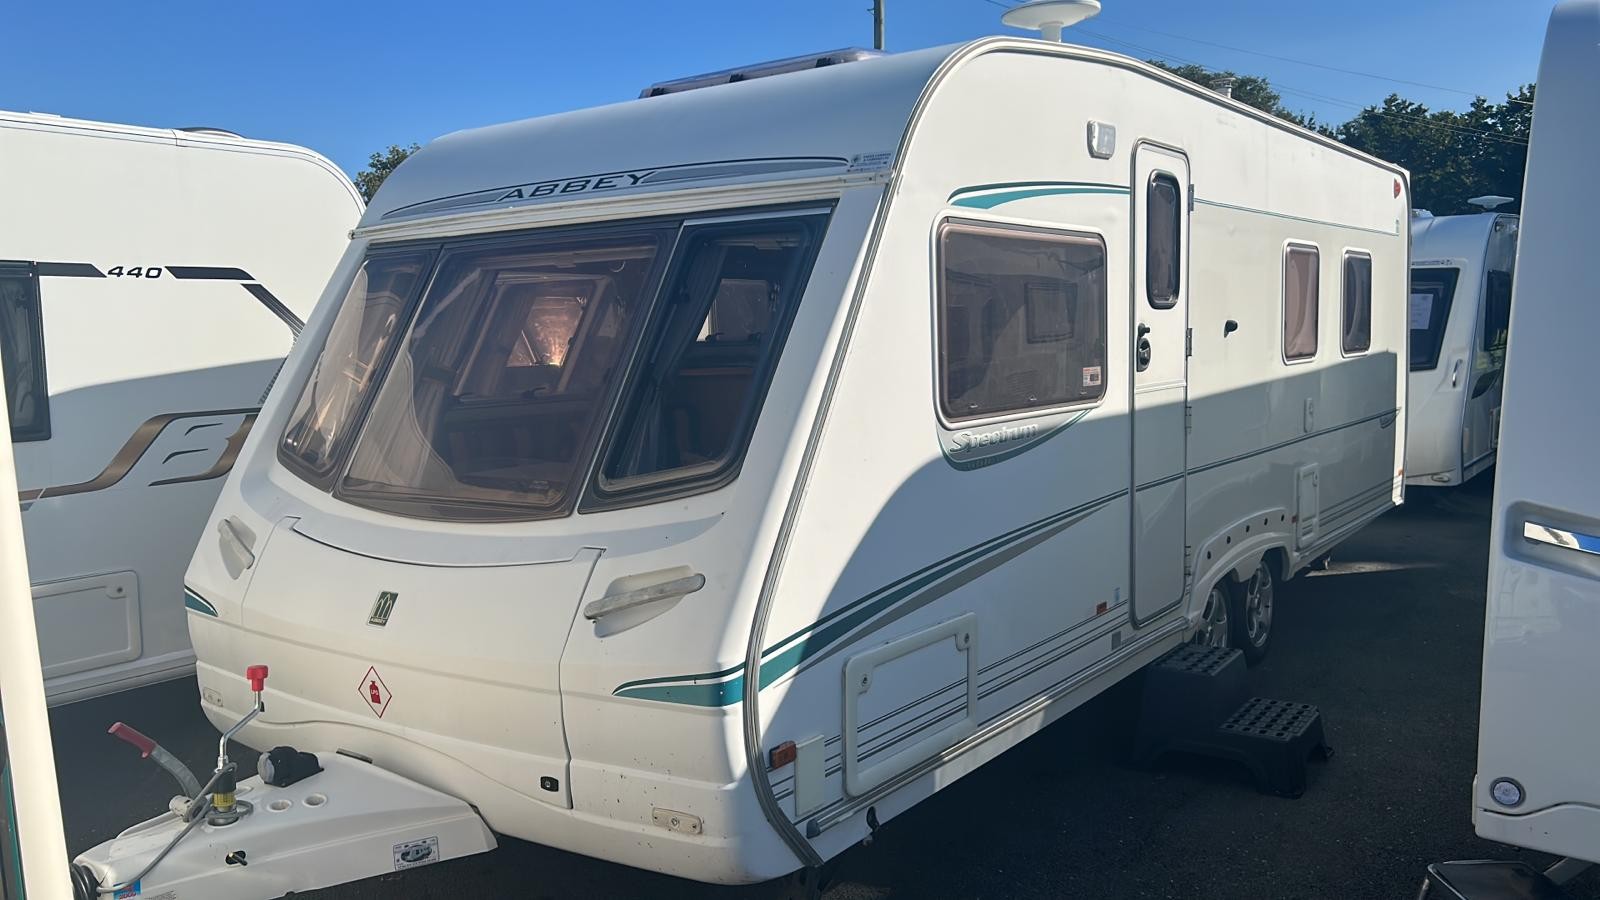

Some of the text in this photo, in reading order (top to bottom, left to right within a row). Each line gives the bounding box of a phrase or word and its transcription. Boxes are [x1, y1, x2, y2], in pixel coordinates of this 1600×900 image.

[497, 171, 656, 202] ABBEY
[107, 265, 163, 279] 440
[949, 423, 1040, 454] Spectrum
